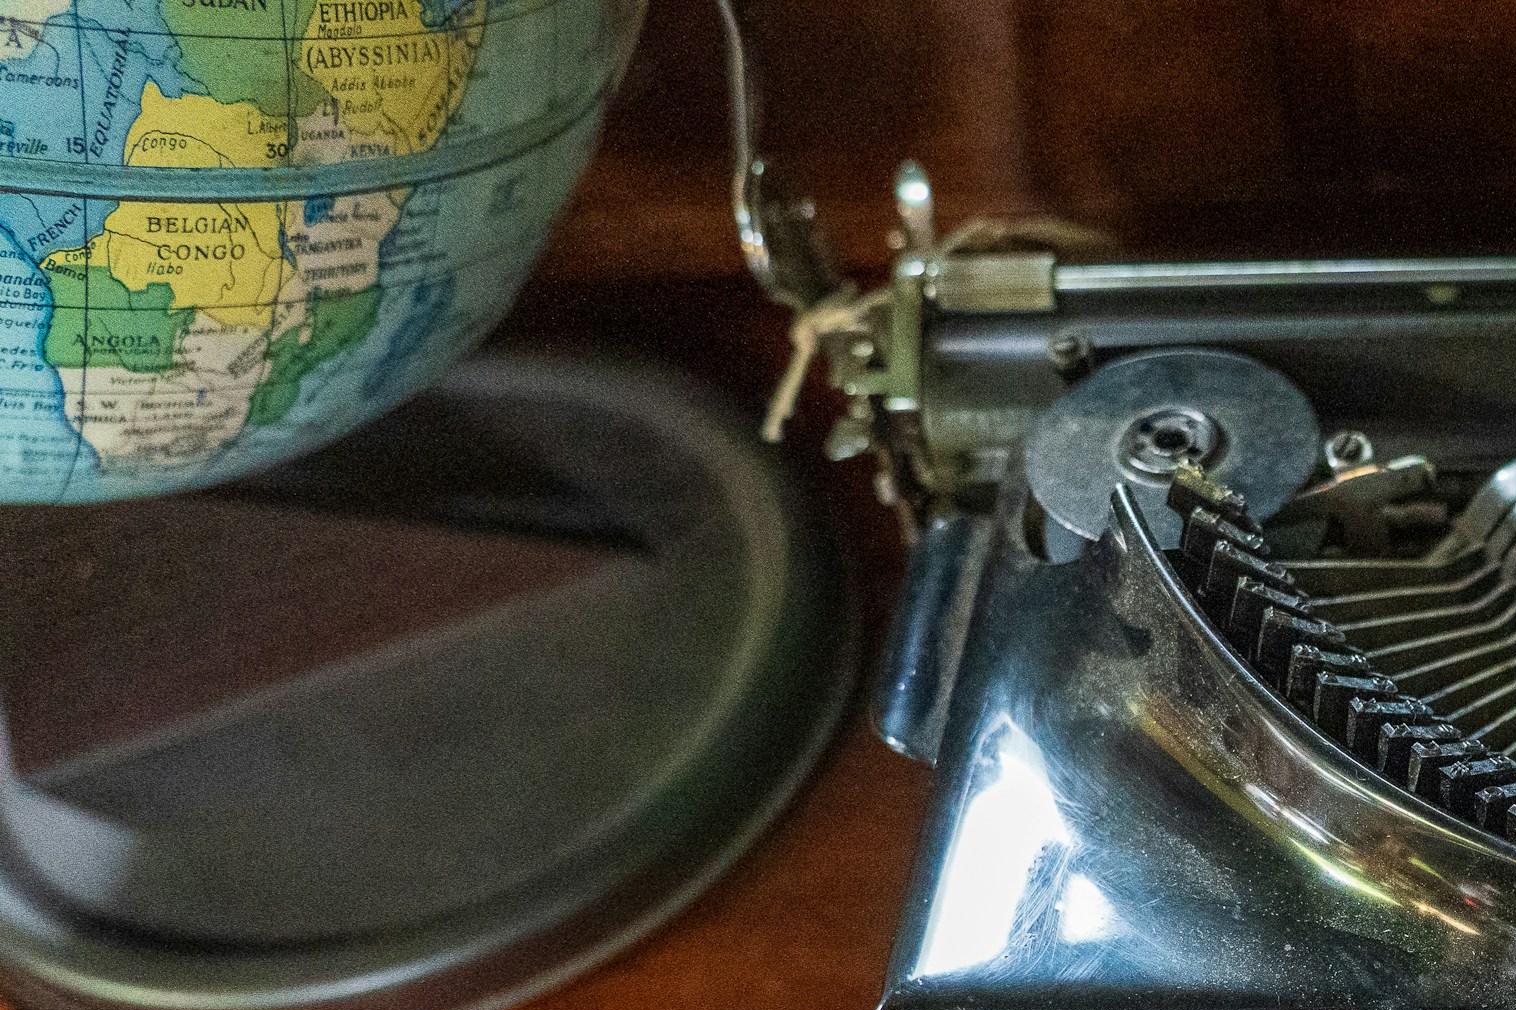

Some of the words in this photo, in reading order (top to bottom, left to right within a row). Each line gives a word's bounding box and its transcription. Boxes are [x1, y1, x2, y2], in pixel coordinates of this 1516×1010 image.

[319, 1, 408, 23] ETHIOPIA
[307, 38, 441, 74] (ABYSSINIA)
[90, 27, 132, 159] EQUATORIAL
[66, 137, 86, 154] 15
[142, 137, 188, 152] Congo
[266, 143, 289, 160] 30
[27, 204, 83, 250] FRENCH
[146, 216, 249, 235] BELGIAN
[157, 243, 247, 262] CONGO
[72, 334, 161, 349] ANGOLA
